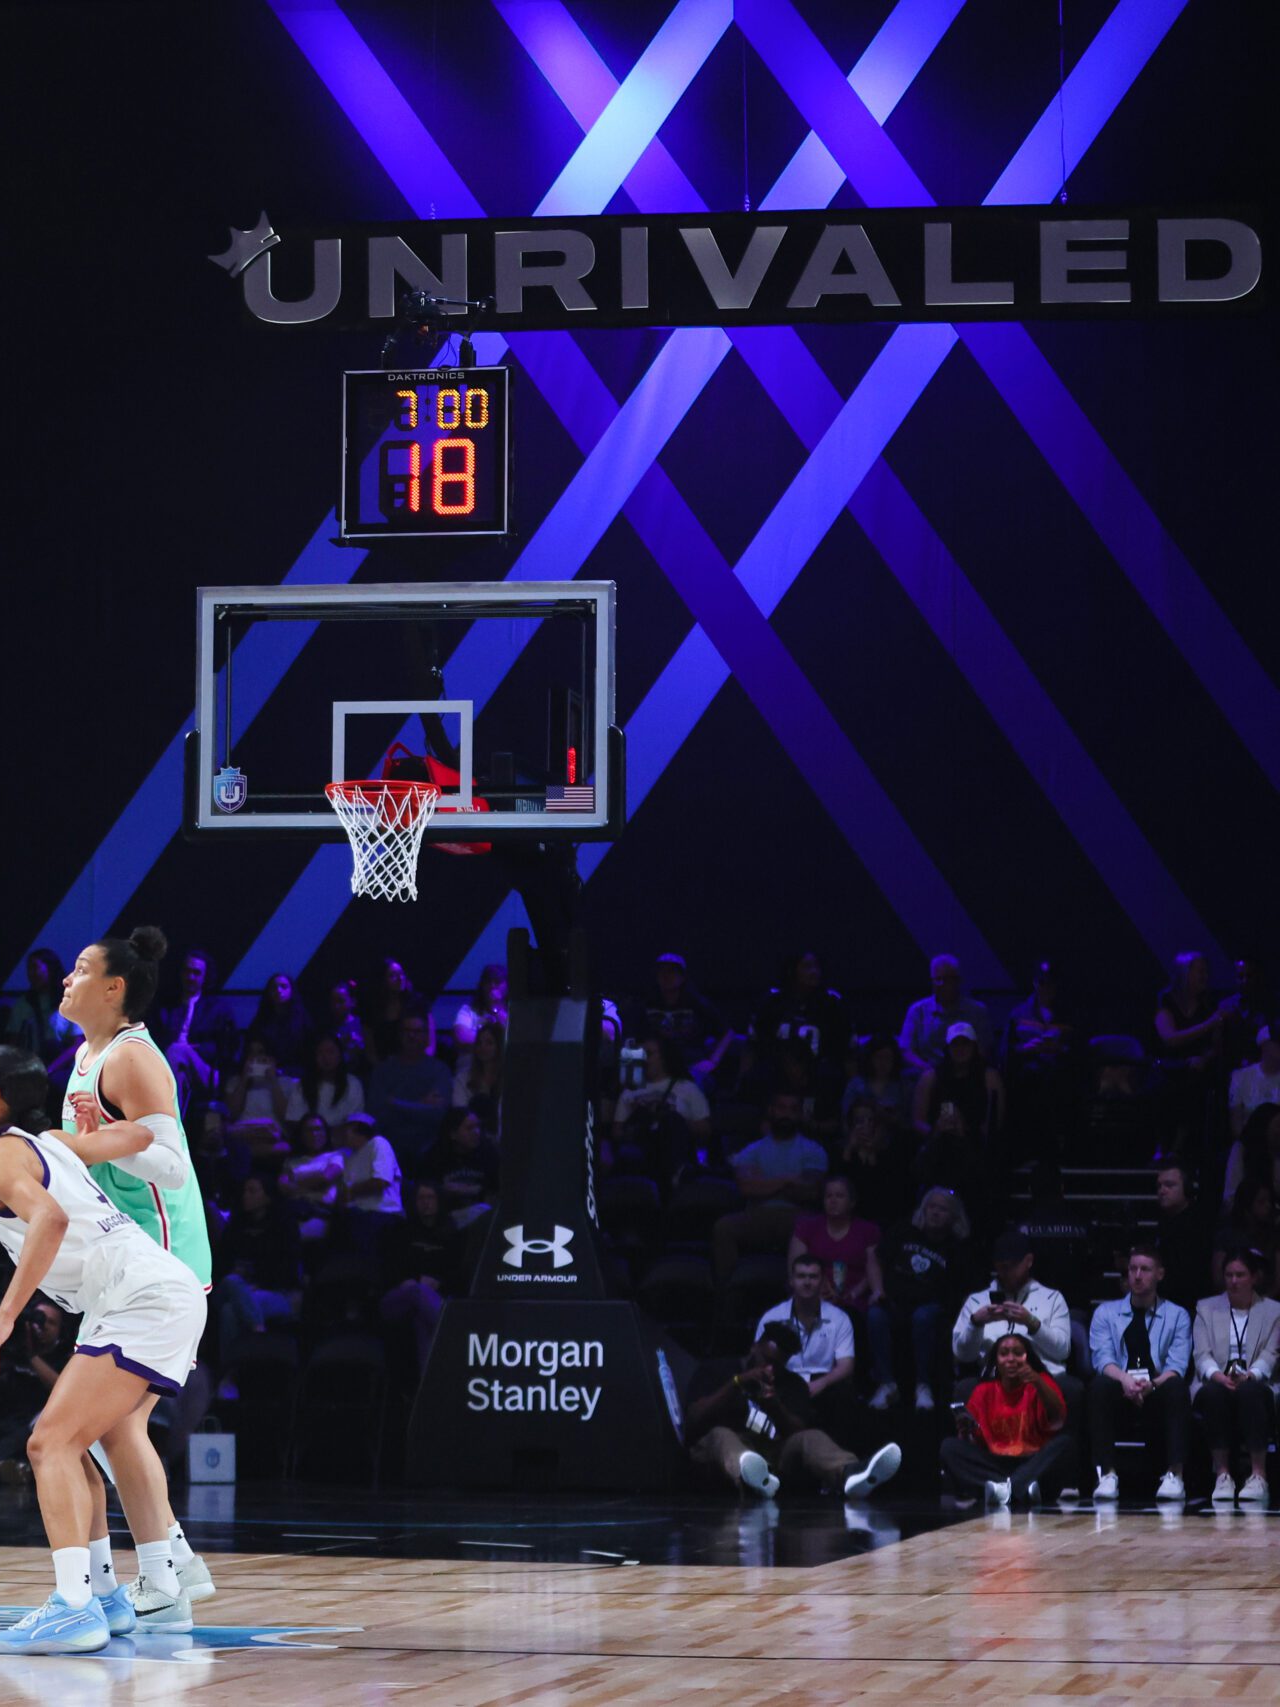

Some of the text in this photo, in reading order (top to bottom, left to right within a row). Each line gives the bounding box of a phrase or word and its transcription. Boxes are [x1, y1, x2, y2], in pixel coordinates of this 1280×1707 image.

[241, 217, 1262, 325] UNRIVALED
[387, 371, 466, 382] DAKTRONICS
[409, 438, 476, 515] 18
[497, 1274, 578, 1283] UNDER ARMOUR
[468, 1333, 604, 1376] Morgan
[467, 1378, 602, 1421] Stanley
